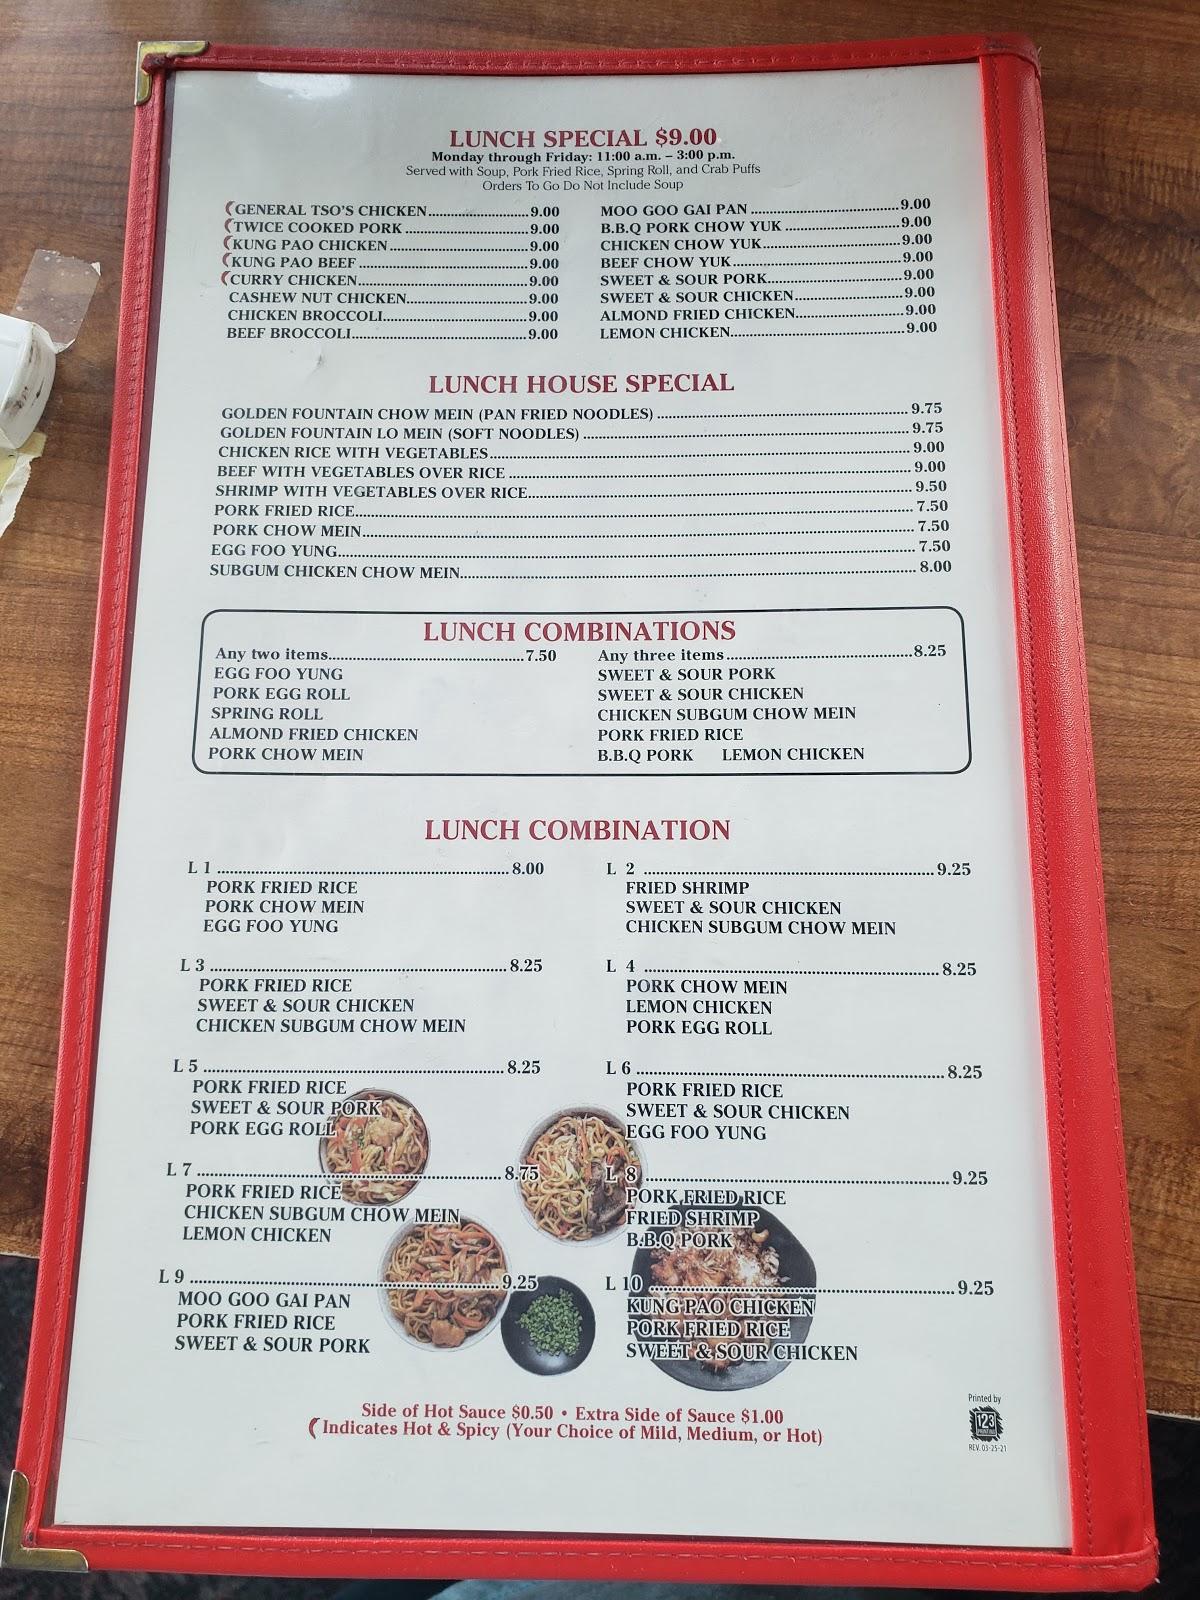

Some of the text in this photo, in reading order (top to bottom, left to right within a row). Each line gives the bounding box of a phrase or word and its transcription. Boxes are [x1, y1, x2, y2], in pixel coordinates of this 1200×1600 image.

[449, 127, 717, 148] LUNCH SPECIAL $9.00
[432, 151, 484, 165] Monday
[488, 151, 541, 165] through
[546, 151, 592, 165] Friday:
[597, 151, 631, 162] 11:00
[634, 152, 661, 161] a.m.
[677, 149, 703, 160] 3:00
[707, 152, 735, 164] p.m.
[406, 163, 761, 179] Served with Soup, Pork Fried Rice, Spring Roll, and Crab Puffs
[482, 179, 684, 193] Orders To Go Do Not Include Soup
[235, 204, 560, 217] GENERAL TSO'S CHICKEN 9.00
[600, 198, 931, 217] MOO GOO GAI PAN 9.00
[231, 256, 559, 269] KUNG PAO BEEF 9.00
[601, 251, 933, 269] BEEF CHOW YUK 9.00
[228, 291, 558, 304] CASHEW NUT CHICKEN 9.00
[600, 304, 936, 322] ALMOND FRIED CHICKEN 9.00
[429, 373, 734, 393] LUNCH HOUSE SPECIAL
[221, 402, 942, 422] GOLDEN FOUNTAIN CHOW MEIN (PAN FRIED NOODLES) 9.75
[215, 480, 947, 499] SHRIMP WITH VEGETABLES OVER RICE 9.50
[211, 540, 950, 557] EGG FOO YUNG 7.50
[424, 620, 735, 641] LUNCH COMBINATIONS
[215, 648, 556, 663] Any two items 7.50
[598, 644, 946, 664] Any three items 8.25
[211, 707, 323, 720] SPRING ROLL
[598, 707, 856, 722] CHICKEN SUBGUM CHOW MEIN
[598, 747, 864, 764] B.B.Q PORK LEMON CHICKEN
[425, 820, 730, 840] LUNCH COMBINATION
[188, 861, 544, 875] L 1 8.00
[606, 862, 971, 876] L 2 9.25
[206, 880, 357, 894] PORK FRIED RICE
[626, 881, 749, 895] FRIED SHRIMP
[626, 999, 772, 1015] LEMON CHICKEN
[167, 1163, 539, 1181] L 7 8.75
[606, 1167, 988, 1186] L 8 9.25
[606, 1276, 993, 1295] L 10 9.25
[178, 1291, 350, 1309] MOO GOO GAI PAN
[626, 1344, 858, 1361] SWEET & SOUR CHICKEN
[968, 1393, 1001, 1404] Printed by
[361, 1403, 784, 1425] Side of Hot Sauce $0.50 Extra Side of Sauce $1.00
[977, 1413, 995, 1428] 123
[323, 1419, 824, 1446] Indicates Hot & Spicy (Your Choice of Mild, Medium, or Hot)
